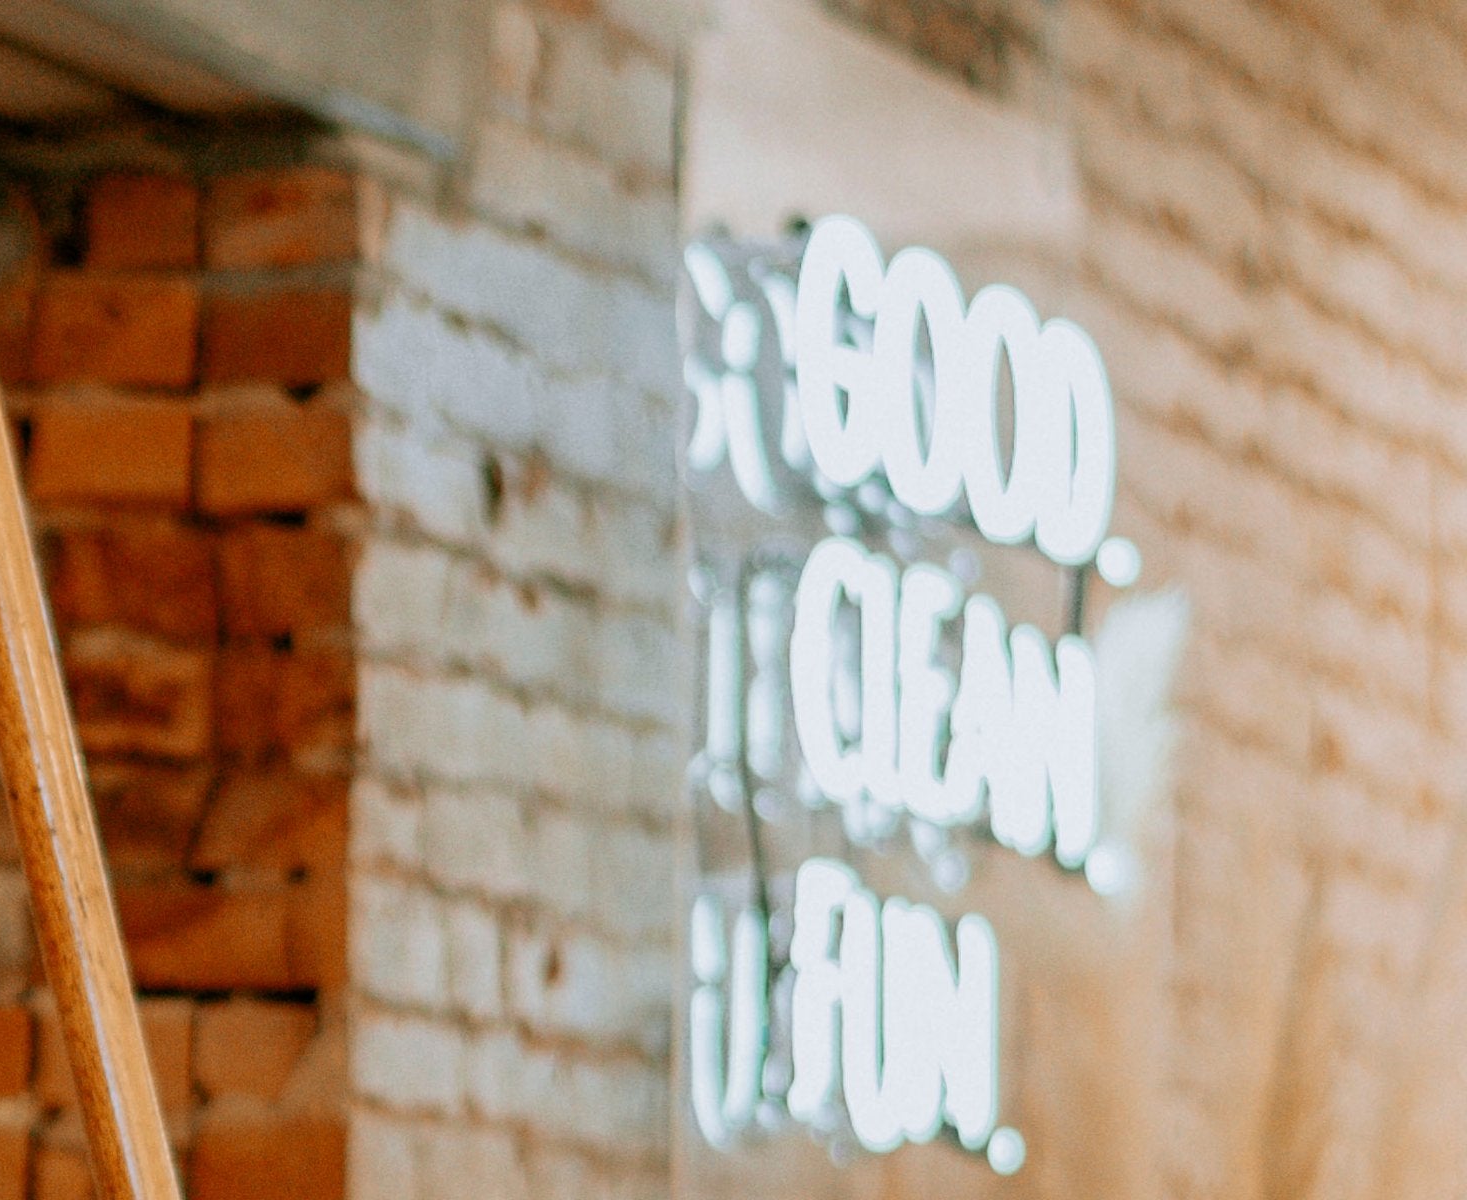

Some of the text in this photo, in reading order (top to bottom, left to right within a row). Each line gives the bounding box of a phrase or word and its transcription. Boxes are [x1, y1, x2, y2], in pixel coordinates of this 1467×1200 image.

[796, 213, 1141, 587] GOOD.
[790, 536, 1127, 897] CLEAN.
[787, 857, 1027, 1176] FUN.
